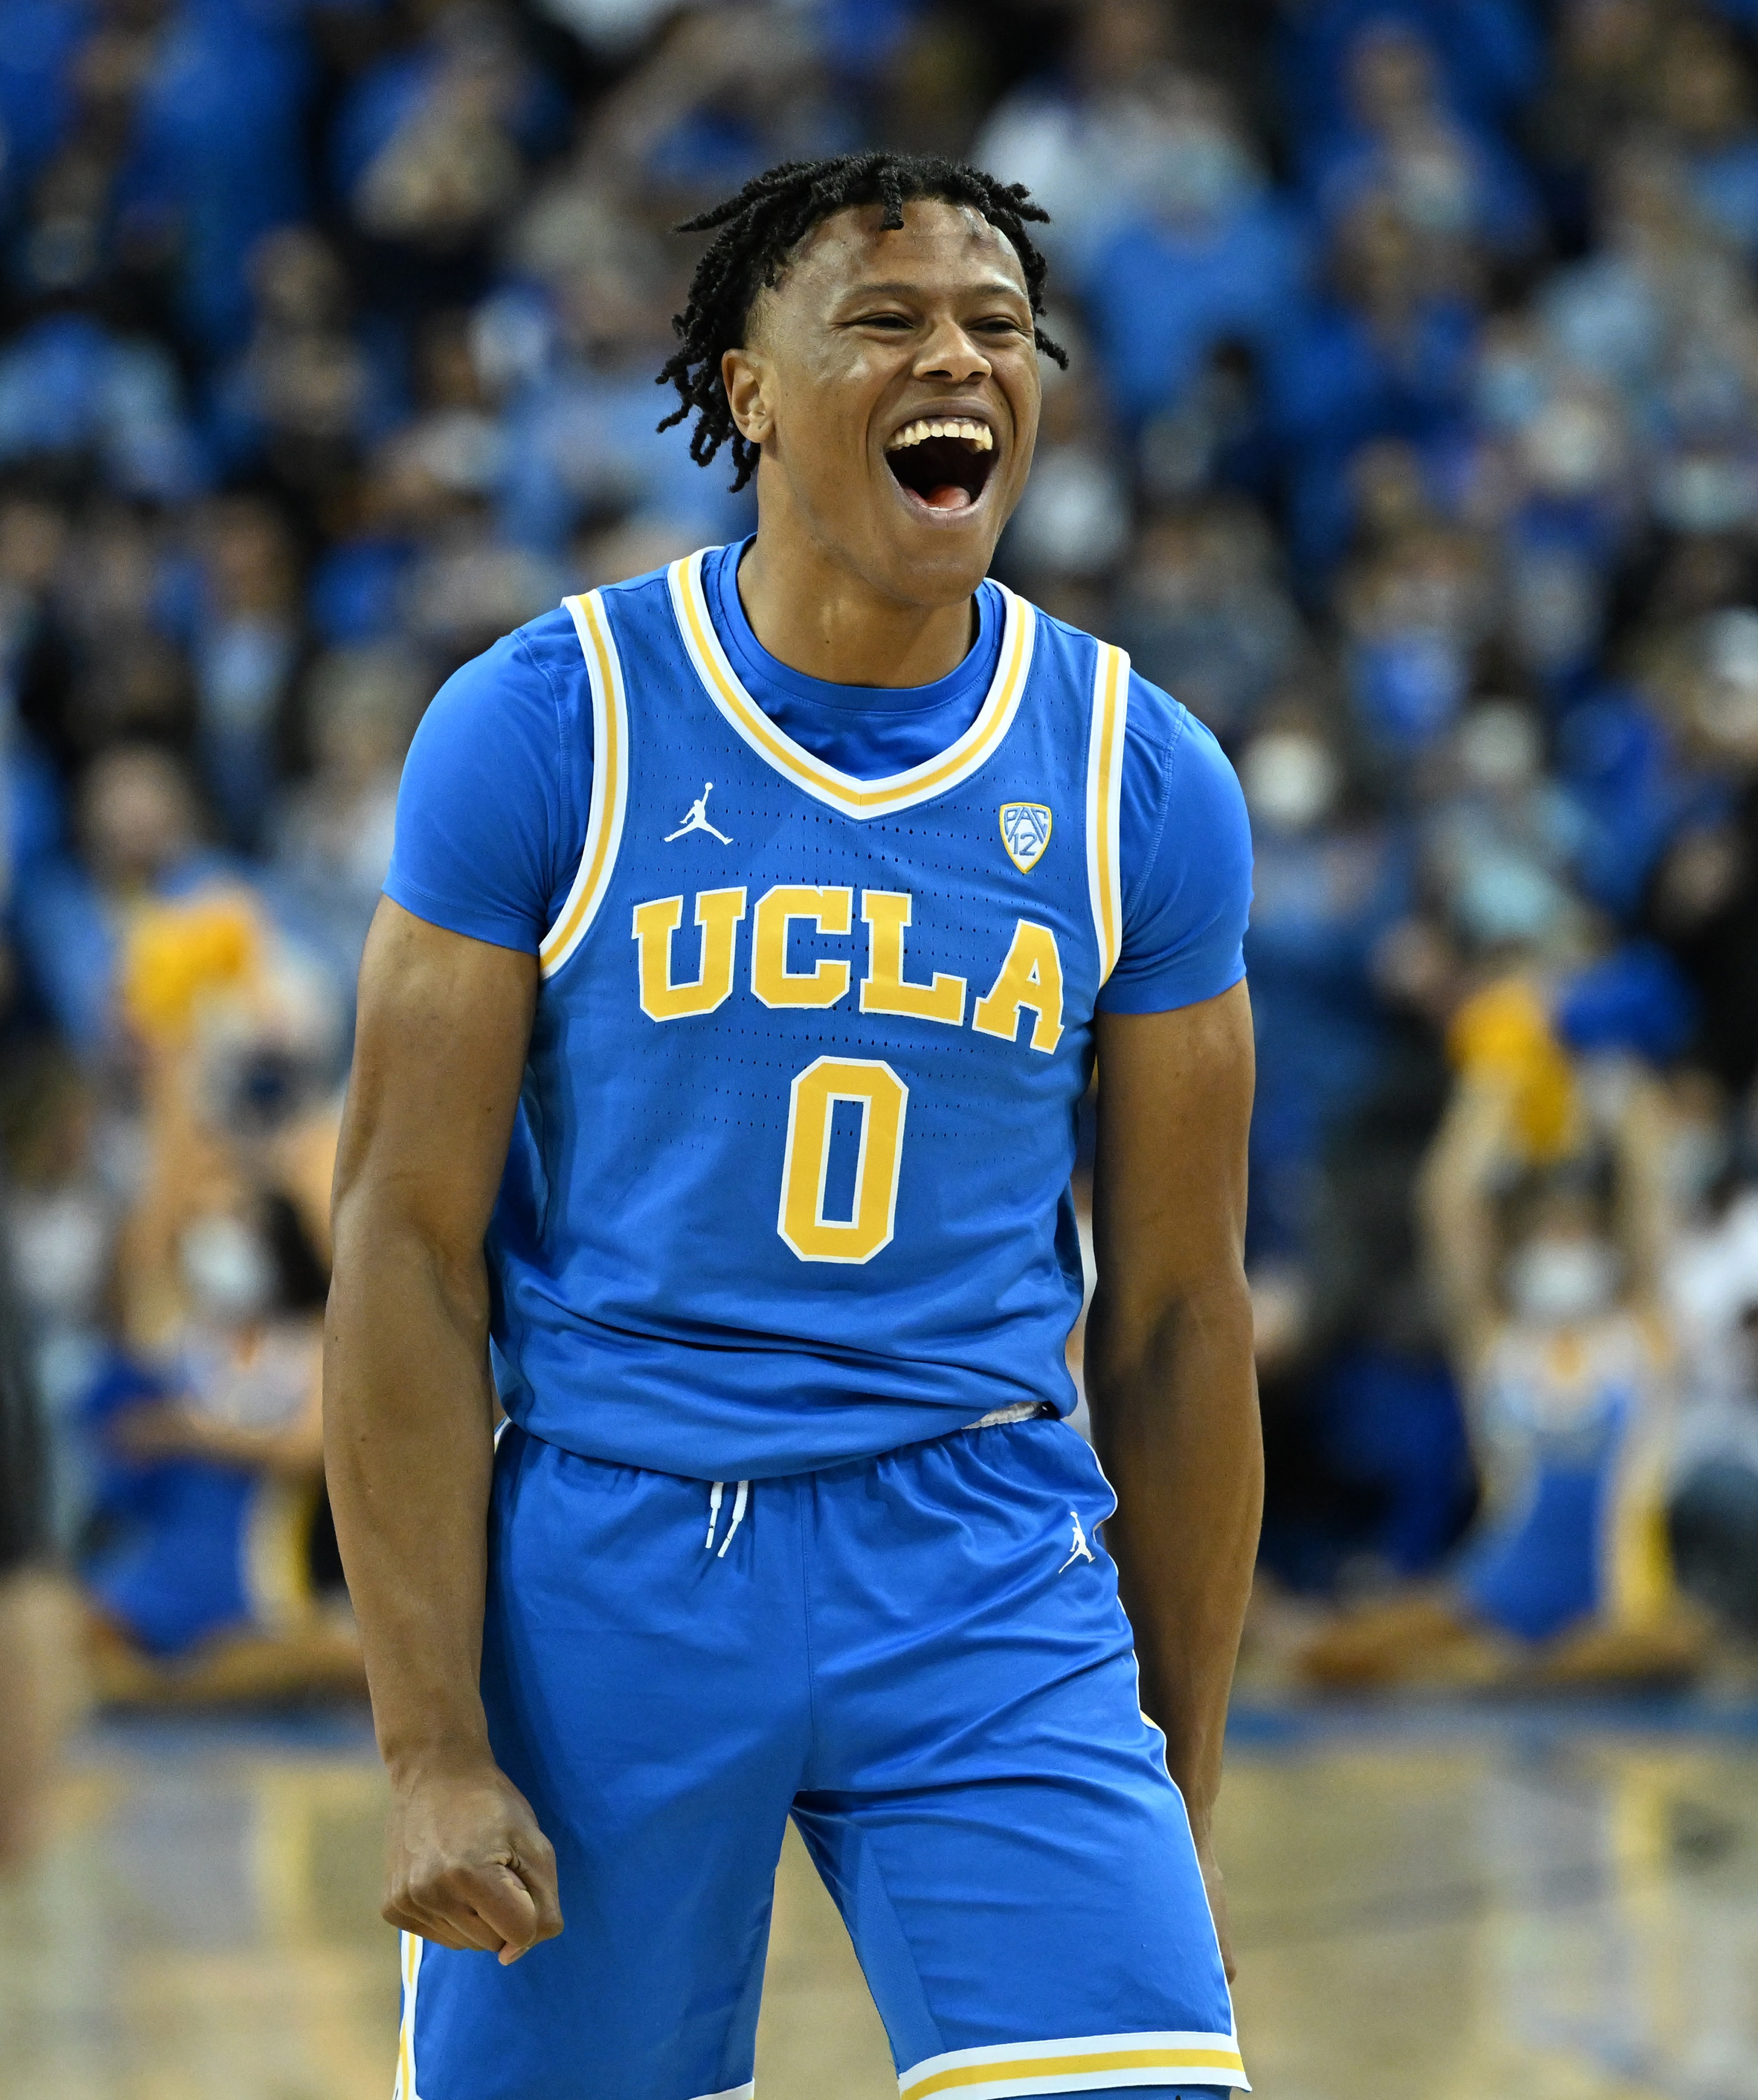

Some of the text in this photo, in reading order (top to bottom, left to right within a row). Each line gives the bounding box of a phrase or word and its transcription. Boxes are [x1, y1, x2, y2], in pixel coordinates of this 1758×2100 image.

[1004, 807, 1048, 844] PAC
[1013, 832, 1038, 856] 12
[632, 885, 1065, 1055] UCLA
[777, 1055, 909, 1264] 0
